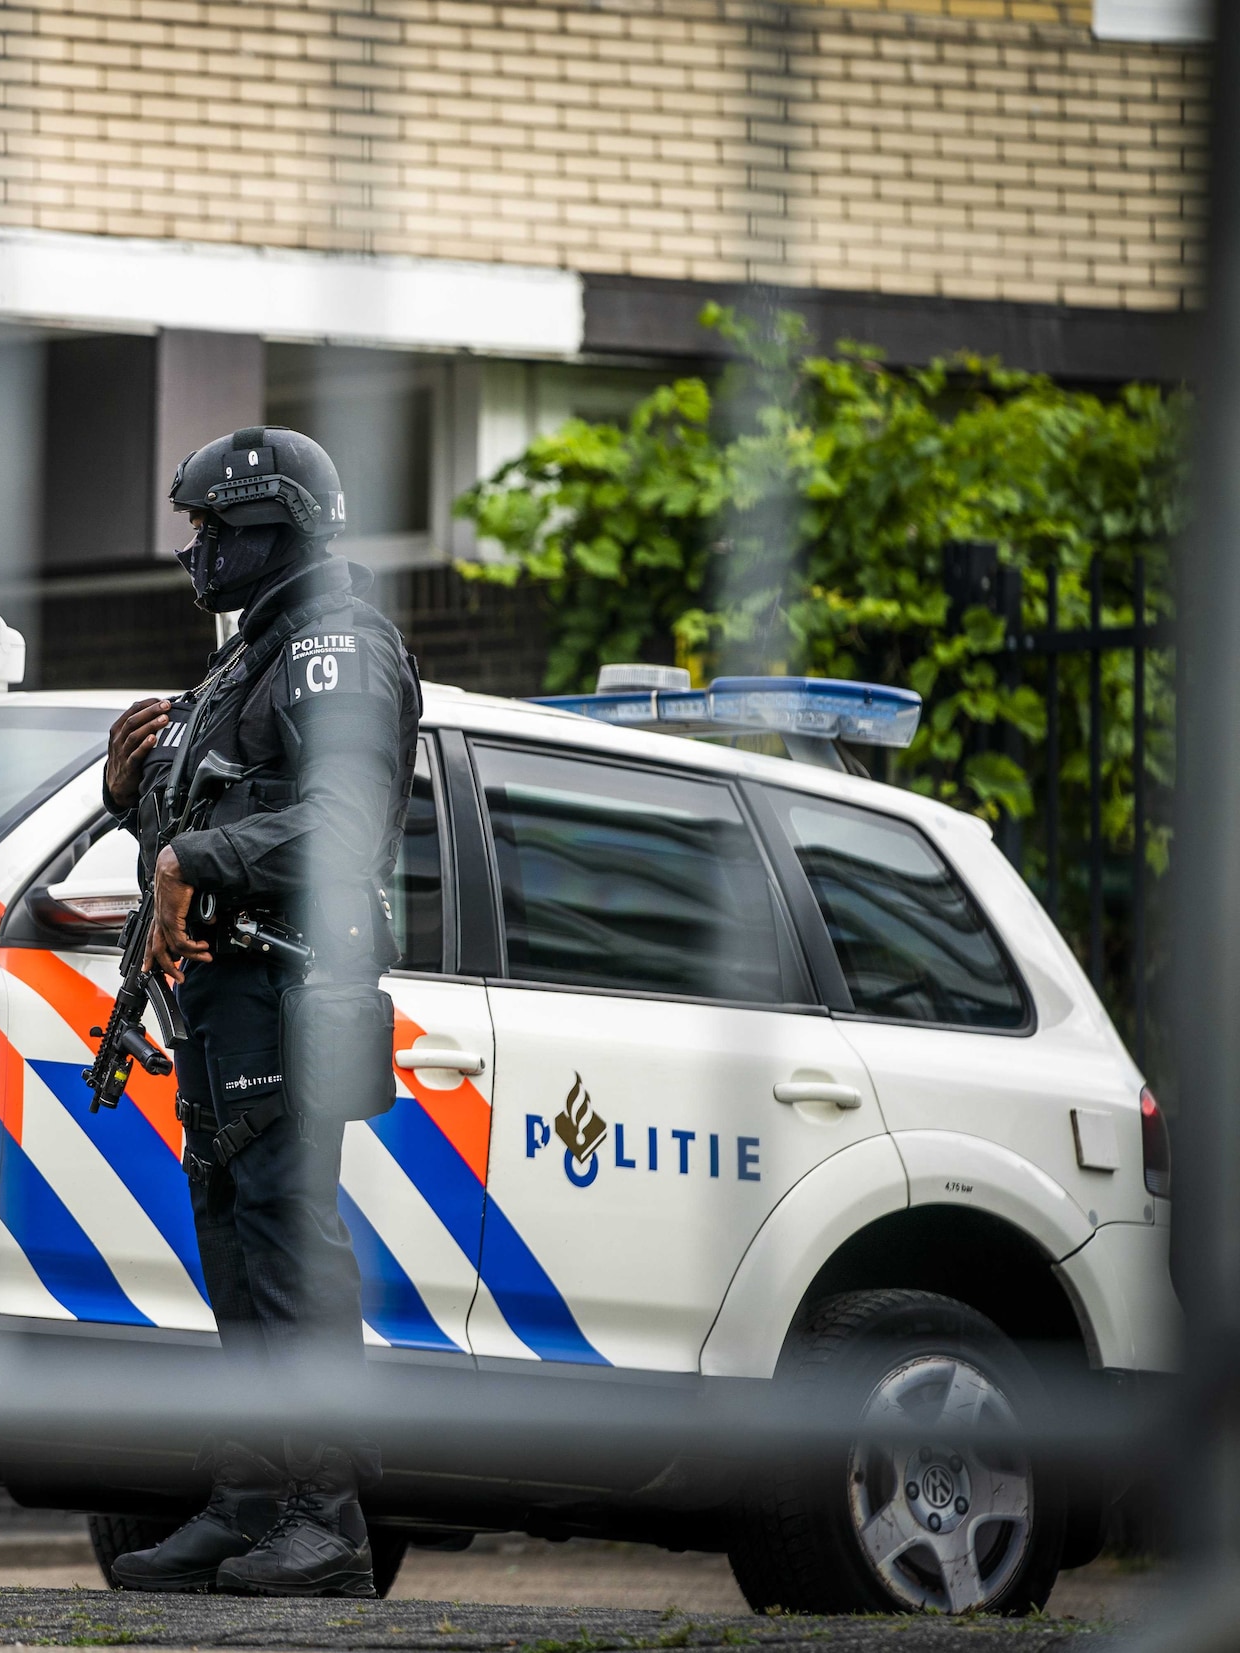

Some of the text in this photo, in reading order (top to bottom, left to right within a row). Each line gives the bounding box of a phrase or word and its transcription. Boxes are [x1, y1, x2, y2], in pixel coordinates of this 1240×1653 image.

[225, 466, 233, 480] 9
[291, 635, 356, 656] POLITIE
[292, 647, 357, 661] BEWAKINGSEENHEID
[306, 654, 339, 693] C9
[294, 687, 301, 700] 9
[234, 1074, 273, 1091] POLITIE
[525, 1112, 762, 1188] POLITIE
